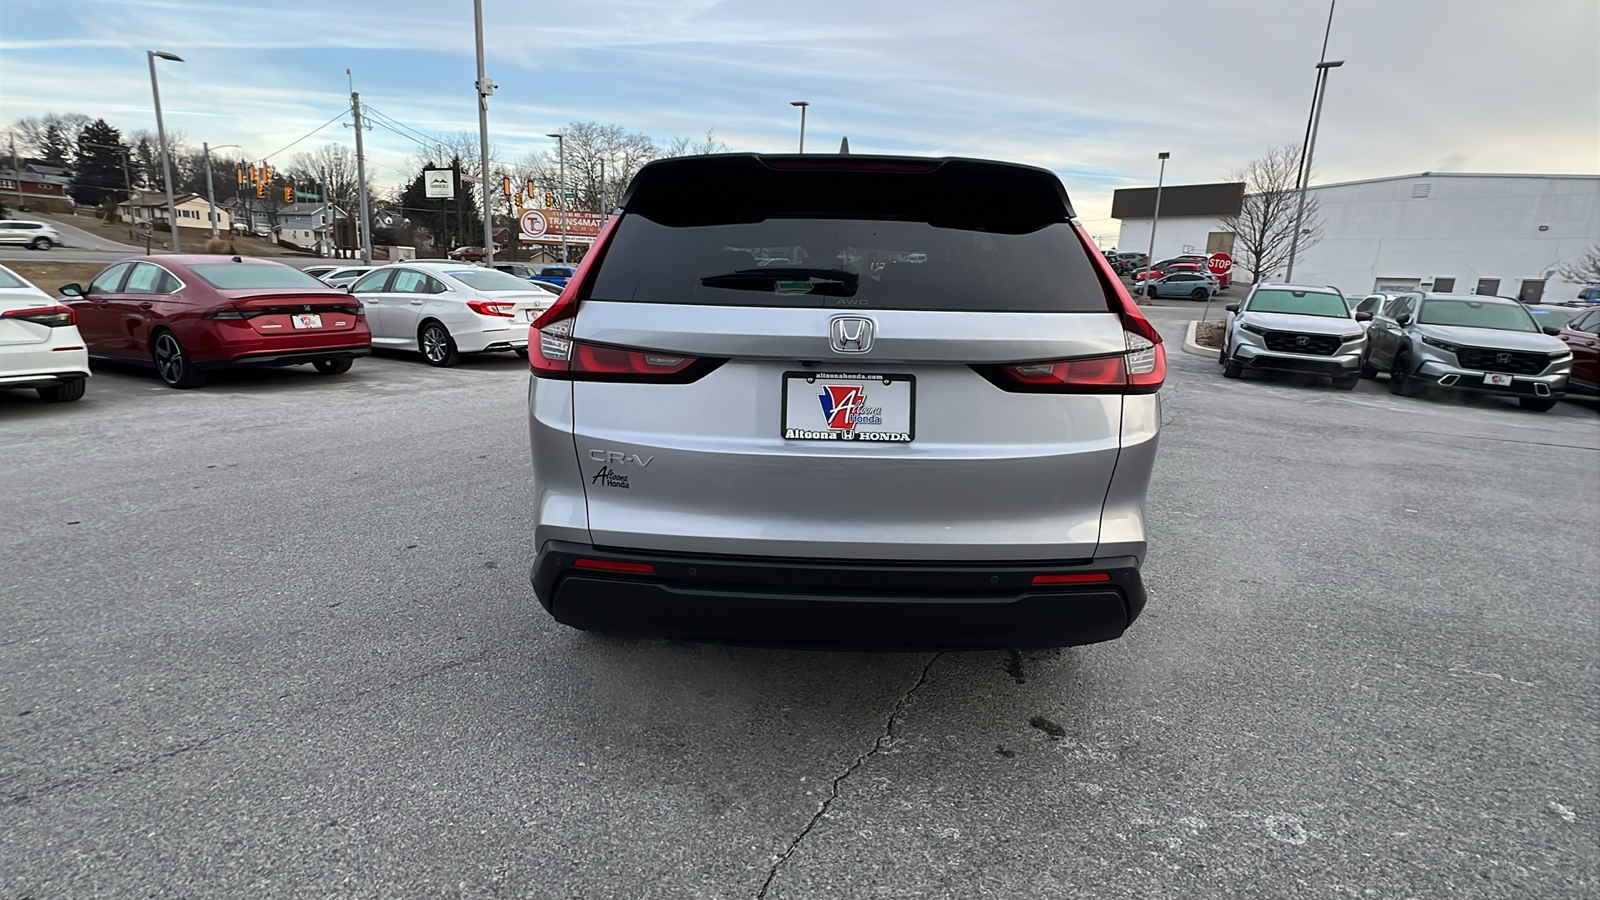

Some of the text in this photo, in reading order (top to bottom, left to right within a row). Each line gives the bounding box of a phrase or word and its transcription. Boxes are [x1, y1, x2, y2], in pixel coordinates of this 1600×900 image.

[550, 217, 608, 226] TRANS4MAT
[1208, 258, 1231, 268] STOP
[828, 390, 881, 423] Altoona
[850, 414, 880, 423] Honda
[786, 429, 910, 441] Altoona HONDA
[589, 449, 654, 467] CR-V
[592, 465, 628, 486] Altoona
[608, 480, 629, 488] Honda
